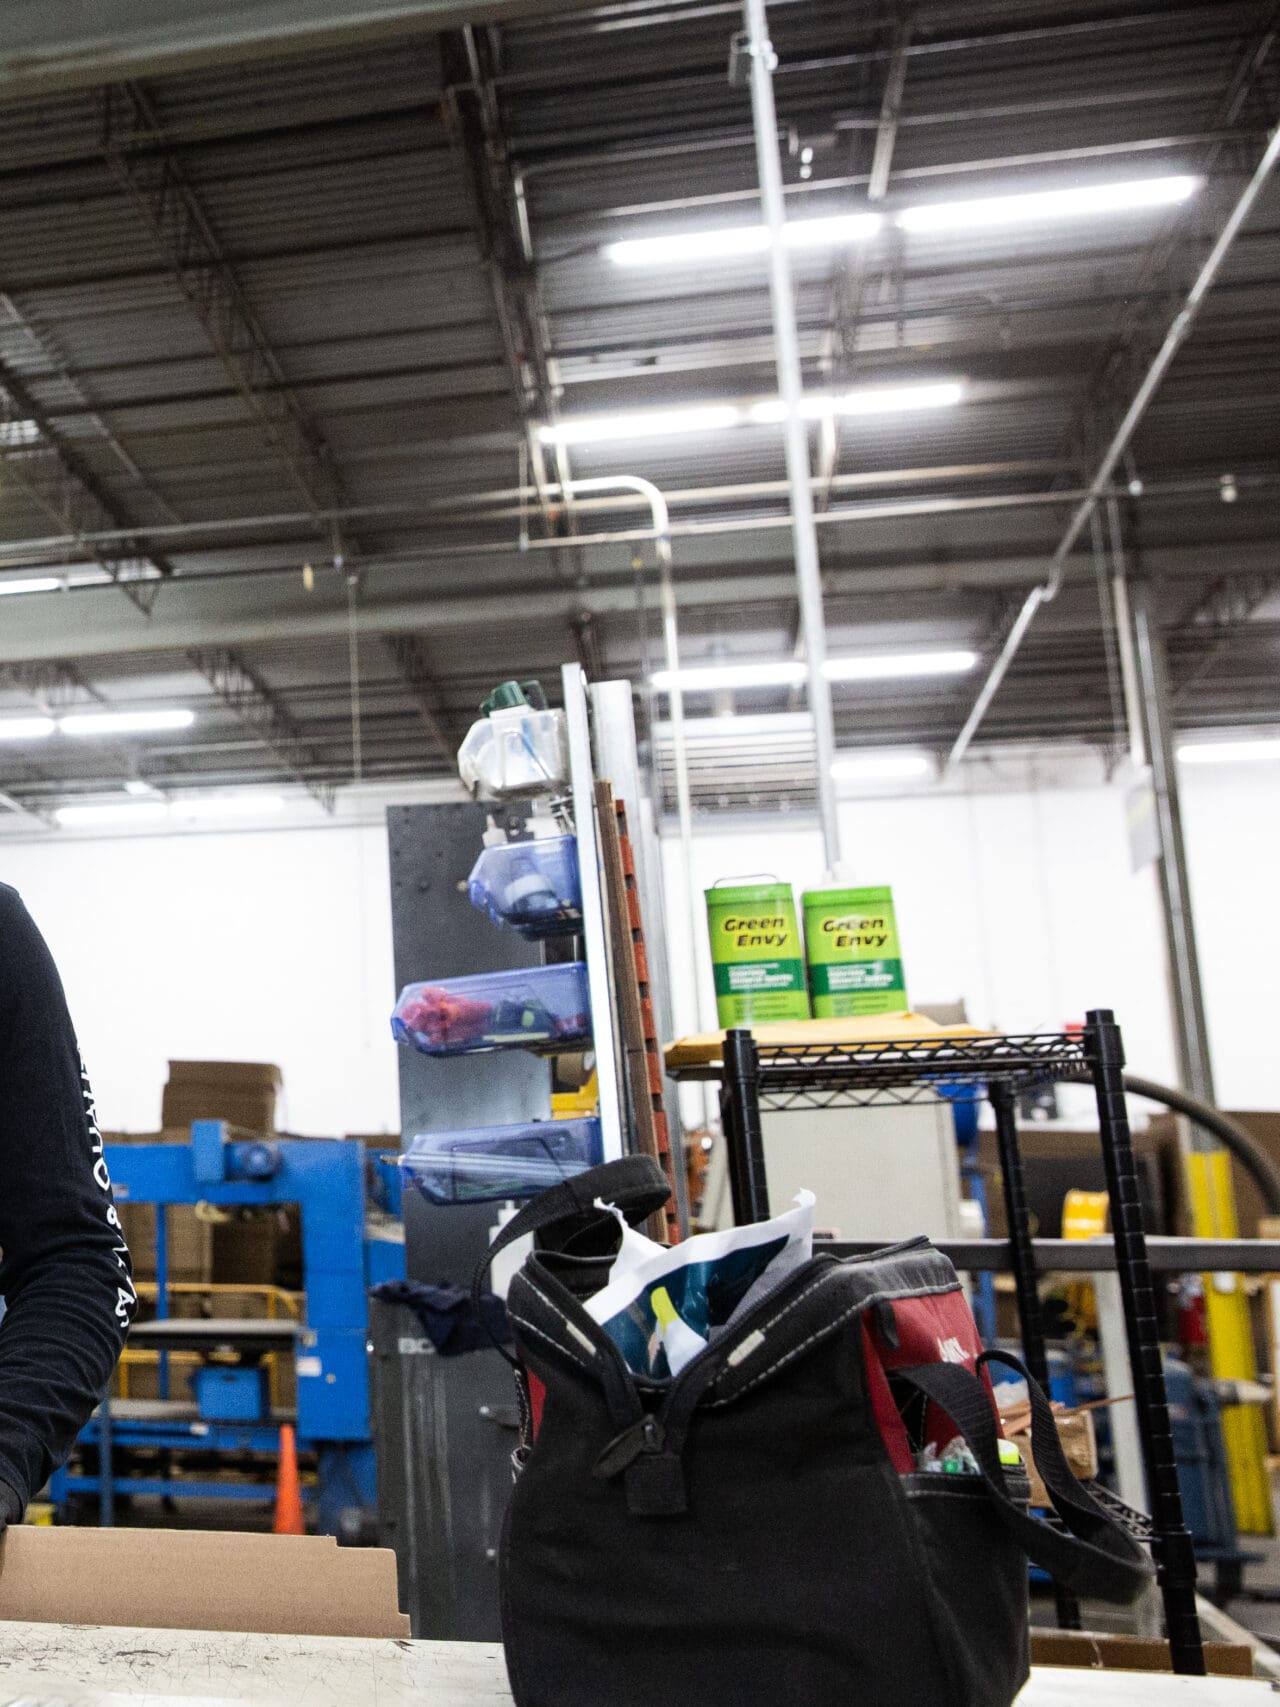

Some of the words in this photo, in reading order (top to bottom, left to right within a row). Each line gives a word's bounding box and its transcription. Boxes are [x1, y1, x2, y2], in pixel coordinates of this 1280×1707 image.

[724, 916, 785, 932] Green
[823, 918, 884, 933] Green
[736, 933, 788, 947] Envy
[836, 934, 888, 948] Envy
